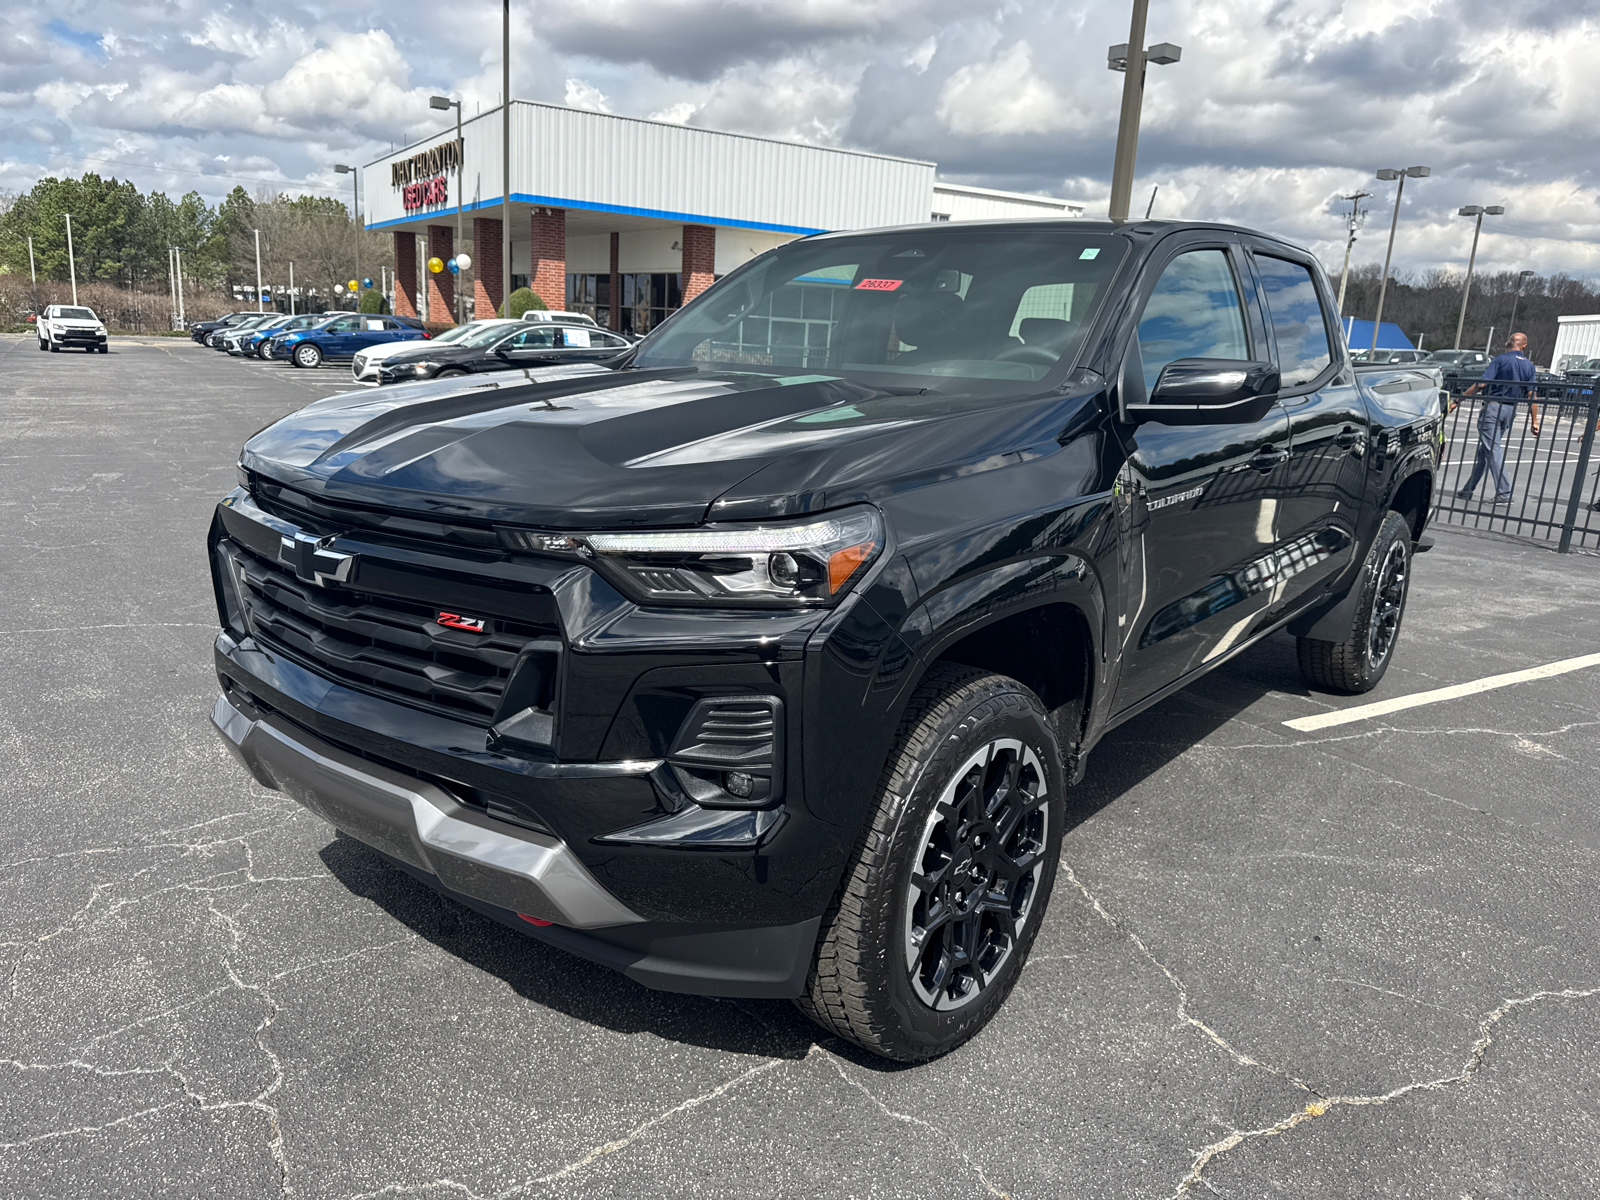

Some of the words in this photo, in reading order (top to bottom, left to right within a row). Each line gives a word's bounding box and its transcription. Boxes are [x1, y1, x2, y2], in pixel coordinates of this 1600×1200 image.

[391, 158, 412, 187] JOHN
[411, 137, 465, 180] THORNTON
[402, 183, 423, 210] USED
[422, 175, 448, 205] CARS
[861, 280, 896, 289] 26337
[1146, 487, 1204, 512] COLORADO
[436, 611, 486, 632] Z71
